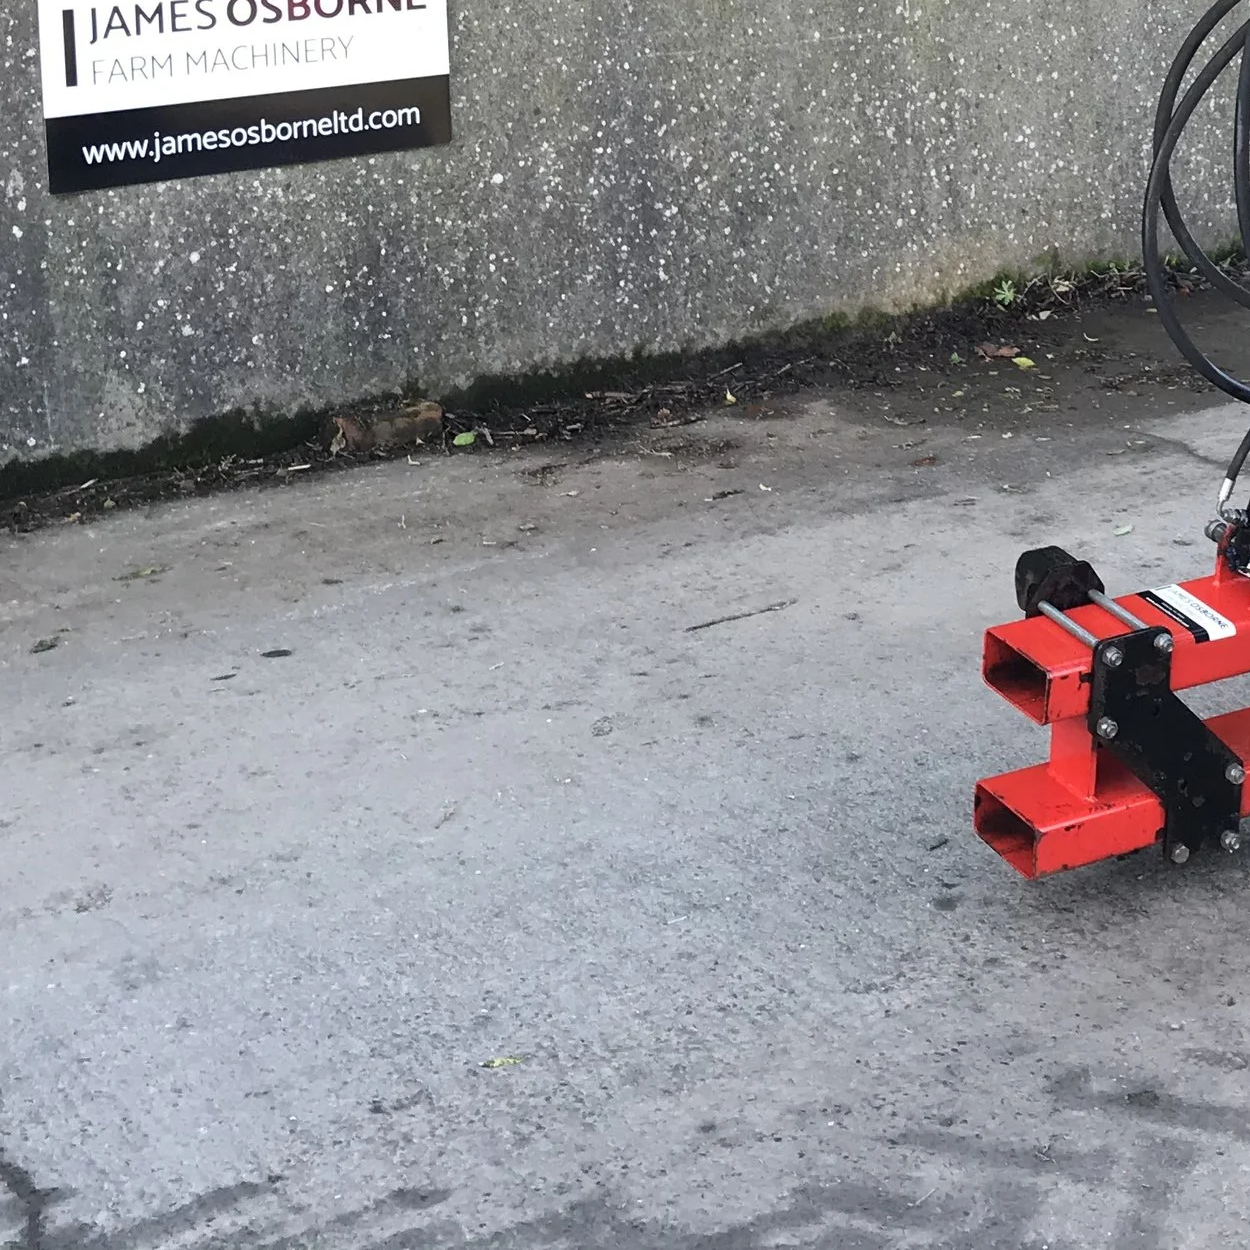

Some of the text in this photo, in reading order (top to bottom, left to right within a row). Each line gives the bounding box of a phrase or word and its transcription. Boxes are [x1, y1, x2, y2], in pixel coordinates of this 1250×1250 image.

[91, 35, 355, 85] FARM MACHINERY
[82, 104, 421, 164] www.jamesosborneltd.com
